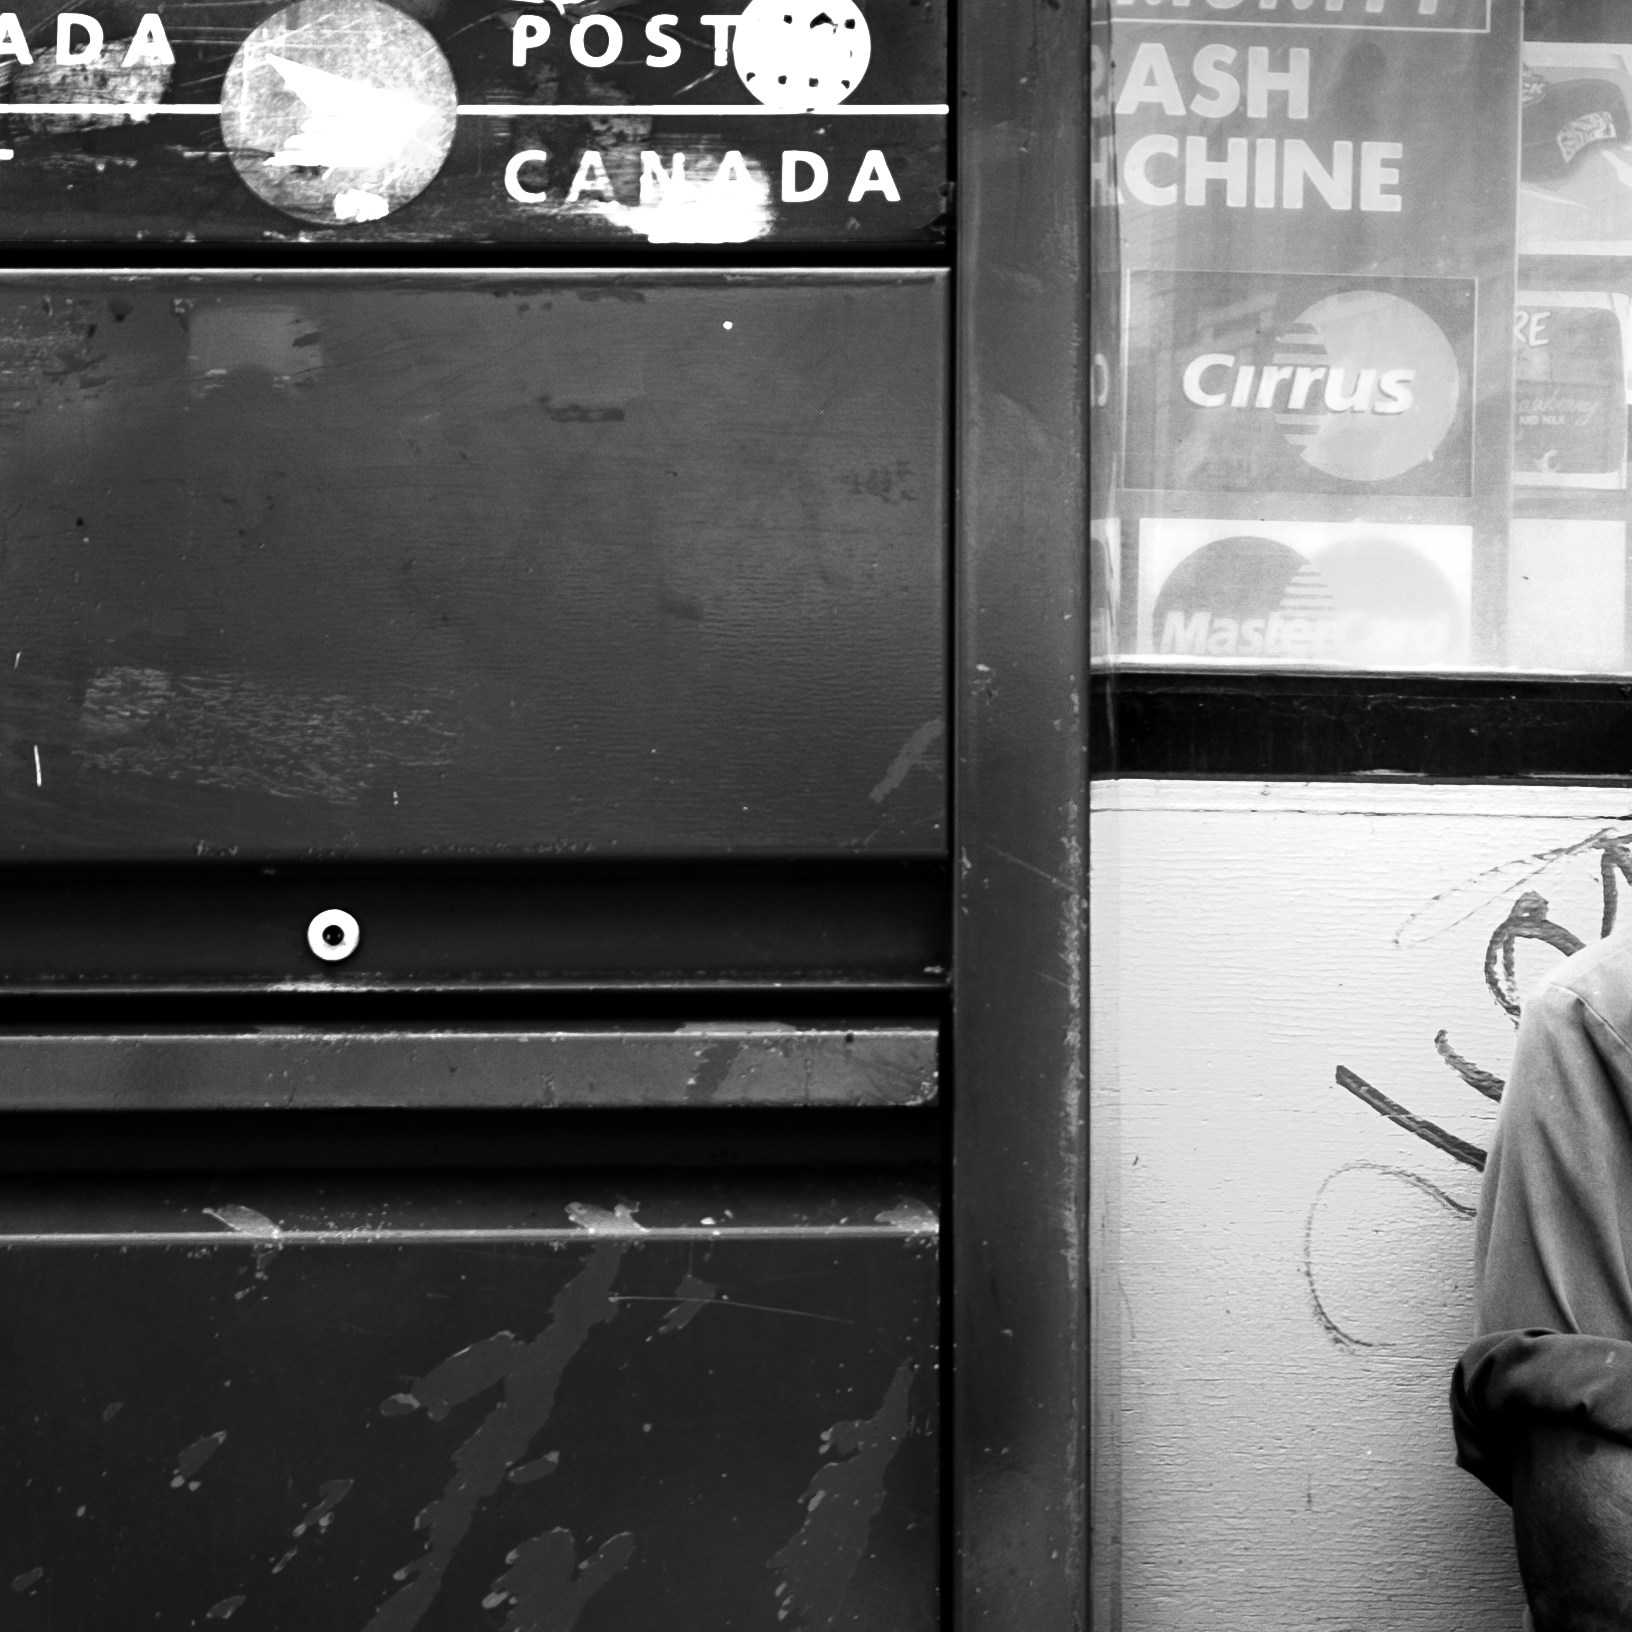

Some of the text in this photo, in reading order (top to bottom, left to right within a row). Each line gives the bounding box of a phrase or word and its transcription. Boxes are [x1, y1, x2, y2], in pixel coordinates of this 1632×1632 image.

[512, 14, 744, 68] POST
[503, 149, 901, 203] CANADA
[1182, 352, 1417, 415] Cirrus
